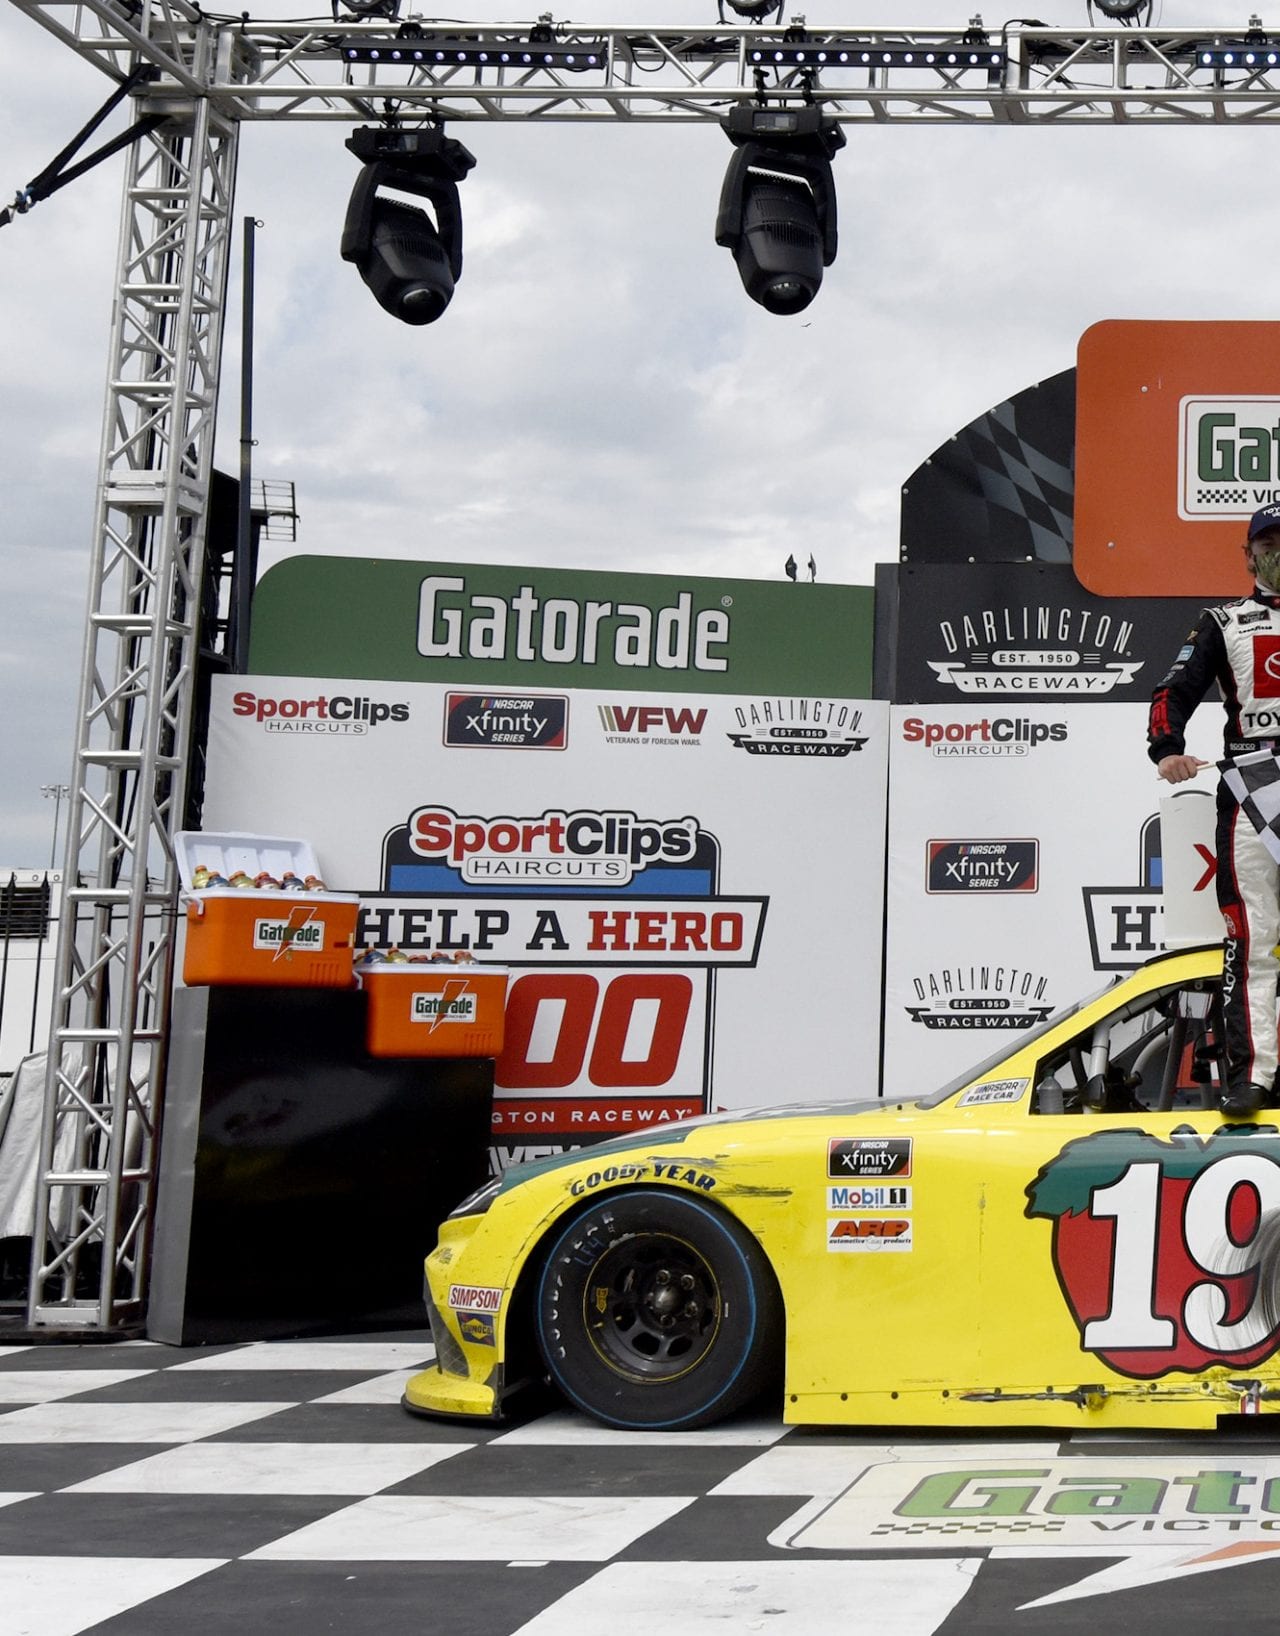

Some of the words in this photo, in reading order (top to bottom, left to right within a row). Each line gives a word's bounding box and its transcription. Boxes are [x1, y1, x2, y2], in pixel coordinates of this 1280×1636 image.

[417, 575, 729, 672] Gatorade
[940, 606, 1134, 654] DARLINGTON
[999, 654, 1031, 663] EST.
[1039, 654, 1073, 663] 1950
[974, 677, 1098, 689] RACEWAY
[233, 692, 410, 725] SportClips
[492, 700, 534, 710] NASCAR
[611, 705, 708, 735] VFW
[734, 699, 863, 731] DARLINGTON
[269, 721, 364, 733] HAIRCUTS
[465, 712, 548, 738] xfinity
[491, 733, 525, 743] SERIES
[773, 729, 797, 738] EST.
[800, 730, 824, 738] 1950
[902, 718, 1068, 746] SportClips
[606, 736, 640, 745] VETERANS
[642, 737, 650, 745] OF
[651, 737, 681, 746] FOREIGN
[758, 743, 840, 755] RACEWAY
[936, 744, 1026, 756] HAIRCUTS
[415, 812, 691, 864] SportClips
[970, 845, 1007, 854] NASCAR
[474, 860, 620, 876] HAIRCUTS
[945, 856, 1020, 882] xfinity
[968, 878, 999, 888] SERIES
[355, 909, 510, 950] HELP
[526, 910, 569, 950] A
[587, 911, 743, 951] HERO
[1223, 939, 1238, 1007] TOYOTA
[913, 966, 1048, 1001] DARLINGTON
[953, 1000, 977, 1009] EST.
[981, 1000, 1006, 1008] 1950
[938, 1017, 1023, 1027] RACEWAY
[494, 973, 693, 1088] 00
[983, 1081, 1019, 1092] NASCAR
[967, 1093, 993, 1102] RACE
[993, 1091, 1014, 1100] CAR
[571, 1109, 687, 1122] RACEWAY
[860, 1141, 889, 1149] NASCAR
[842, 1149, 899, 1170] xfinity
[859, 1167, 883, 1175] SERIES
[832, 1188, 884, 1204] Mobil
[830, 1220, 910, 1238] ARP
[883, 1237, 912, 1245] products
[450, 1287, 500, 1309] SIMPSON
[463, 1323, 492, 1335] SUNOCO
